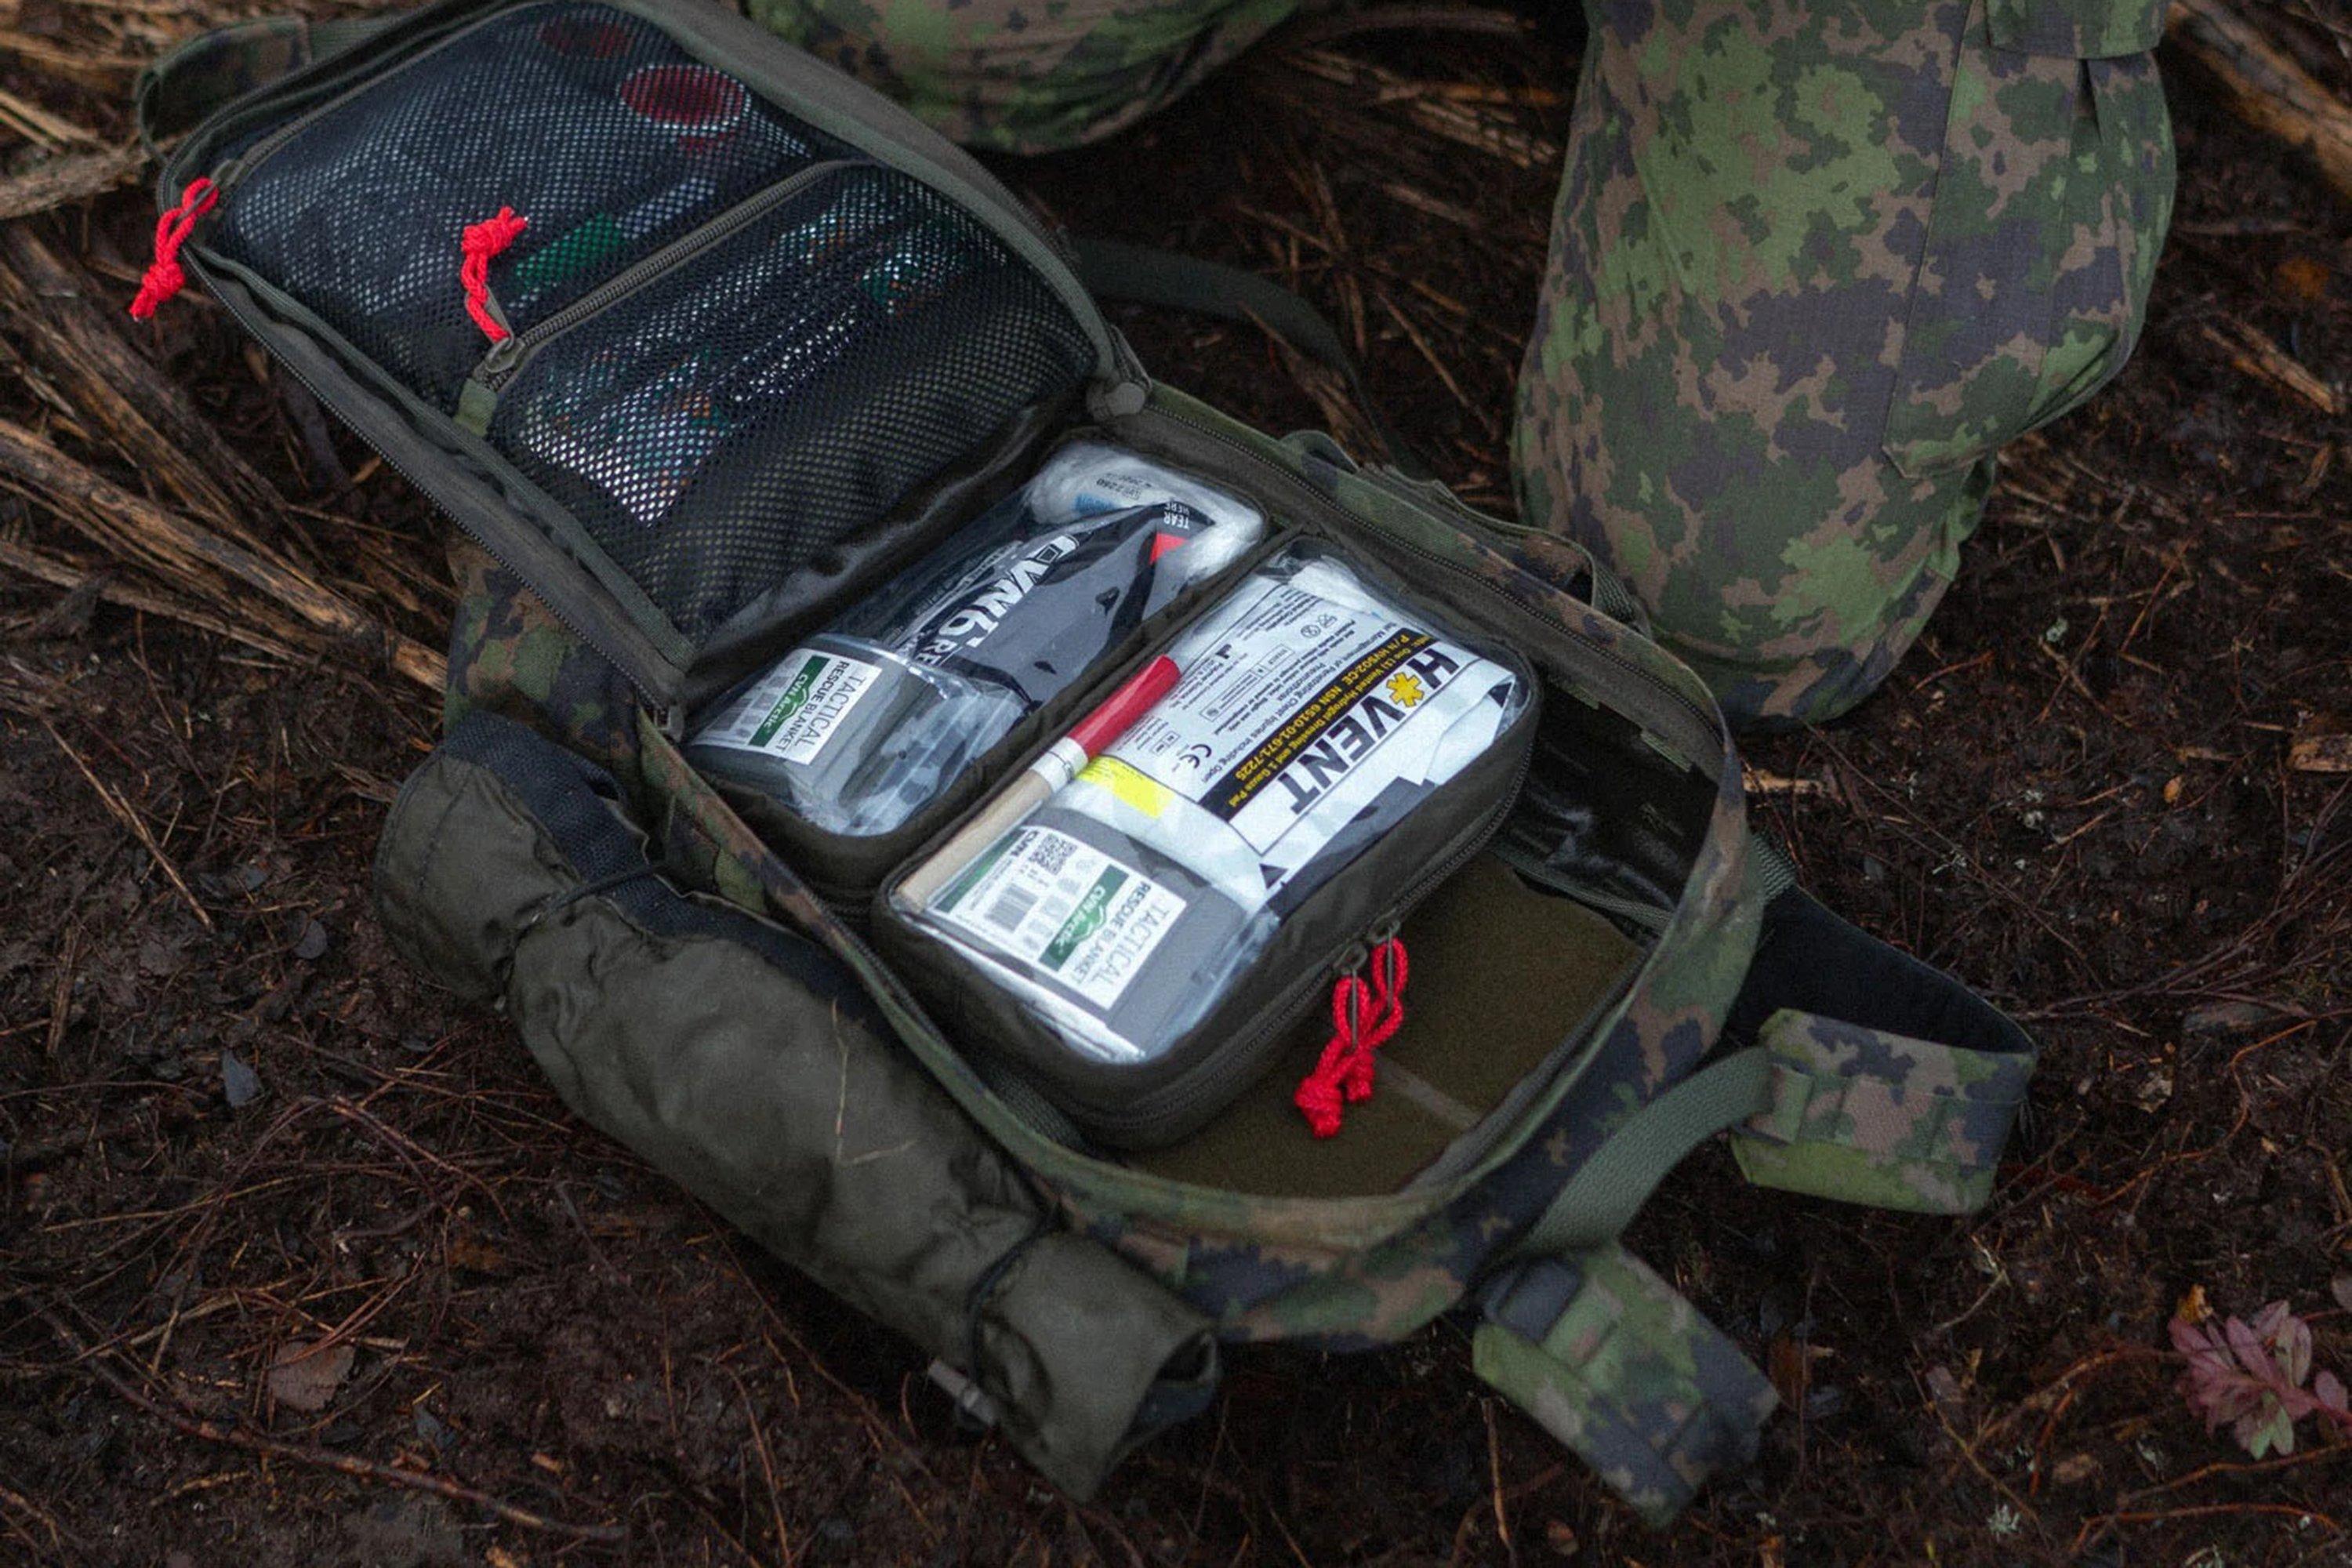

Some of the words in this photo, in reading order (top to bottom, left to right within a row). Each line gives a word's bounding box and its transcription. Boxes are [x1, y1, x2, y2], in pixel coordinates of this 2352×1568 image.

[1163, 511, 1189, 529] TEAR
[786, 673, 809, 696] CVN
[810, 659, 849, 702] RESCUE
[1317, 684, 1342, 706] NSN
[762, 696, 791, 729] Arctic
[774, 701, 818, 753] BLANKET
[793, 674, 866, 747] TACTICAL
[1080, 884, 1107, 914] CVN
[1109, 880, 1152, 930] RESCUE
[1069, 927, 1117, 985] BLANKET
[1091, 904, 1170, 986] TACTICAL
